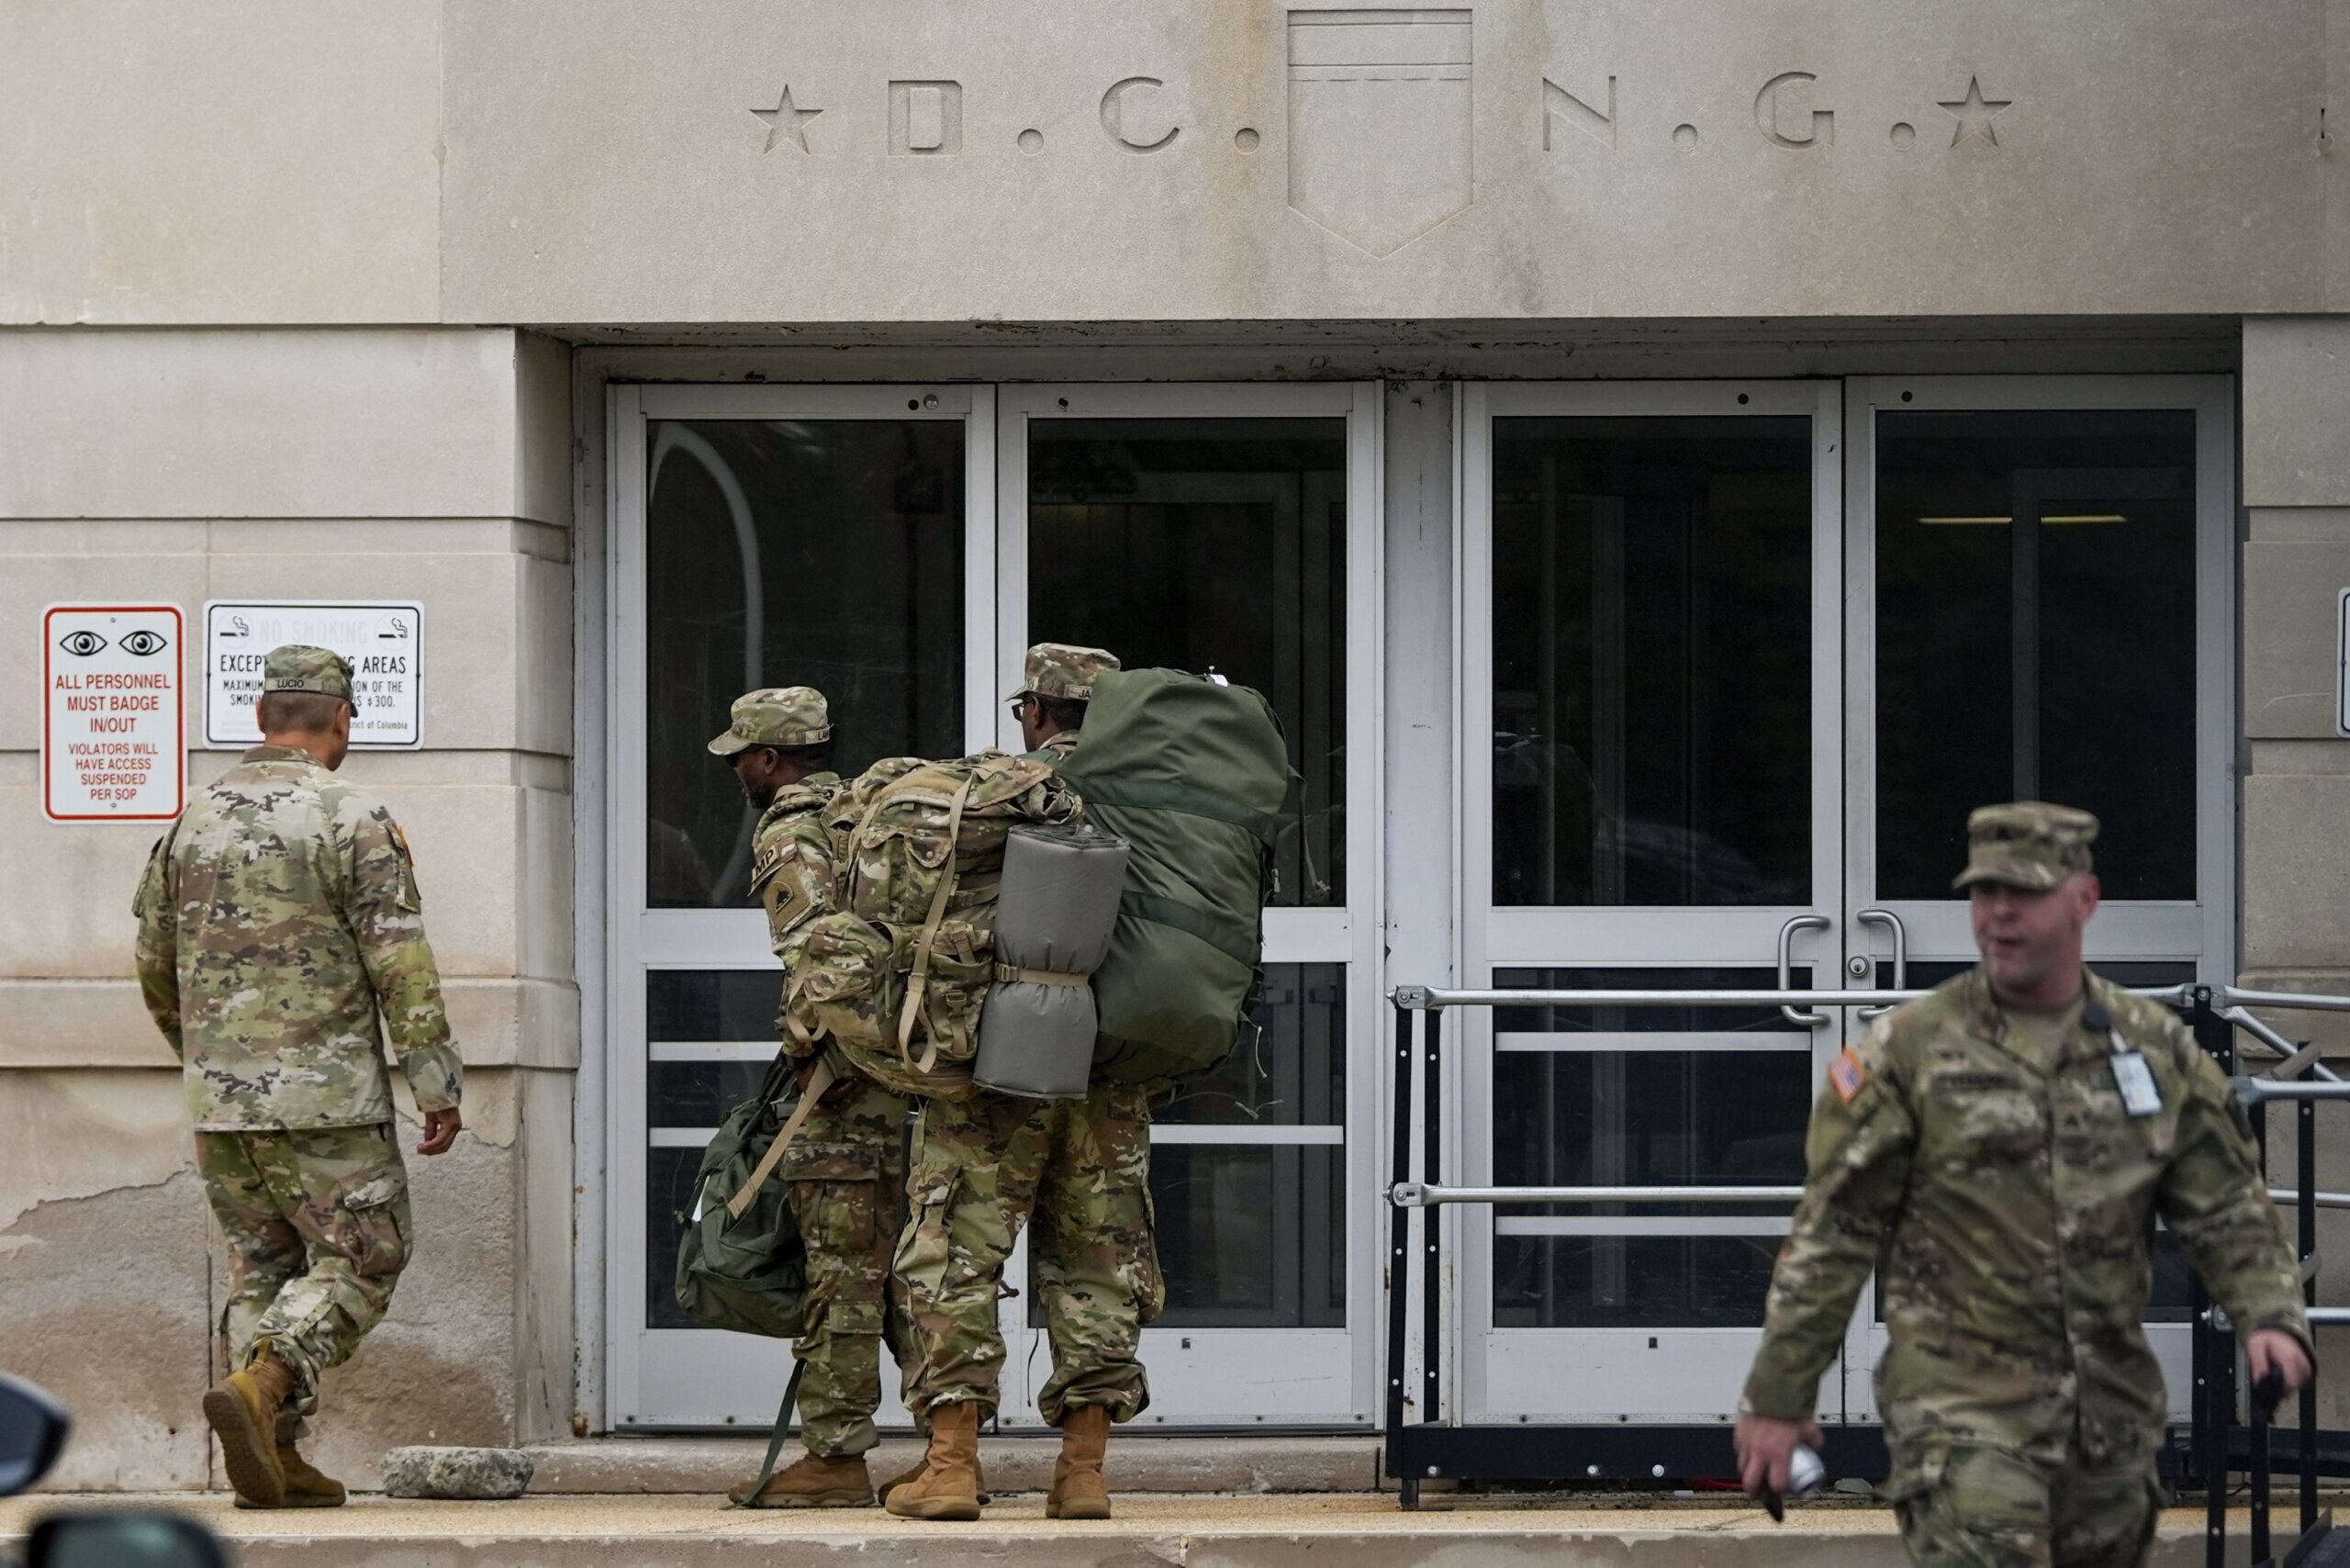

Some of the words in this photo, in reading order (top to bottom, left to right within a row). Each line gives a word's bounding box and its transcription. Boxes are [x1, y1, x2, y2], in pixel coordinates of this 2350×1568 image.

[260, 620, 282, 644] NO
[292, 620, 368, 644] SMOKING
[220, 655, 266, 672] EXCEP
[363, 656, 407, 674] AREAS
[55, 674, 82, 689] ALL
[85, 674, 172, 689] PERSONNEL
[223, 679, 264, 691] MAXIMUM
[372, 681, 383, 692] OF
[387, 681, 404, 693] THE
[277, 678, 305, 689] LUCIO
[1079, 689, 1091, 699] JA
[67, 696, 106, 711] MUST
[109, 696, 160, 711] BADGE
[90, 717, 137, 733] IN/OUT
[367, 720, 375, 730] of
[376, 720, 408, 730] Columbia
[68, 743, 130, 756] VIOLATORS
[132, 743, 159, 755] WILL
[75, 758, 106, 770] HAVE
[107, 758, 152, 770] ACCESS
[81, 773, 147, 786] SUSPENDED
[90, 789, 112, 801] PER
[115, 789, 137, 801] SOP
[755, 848, 775, 877] MP
